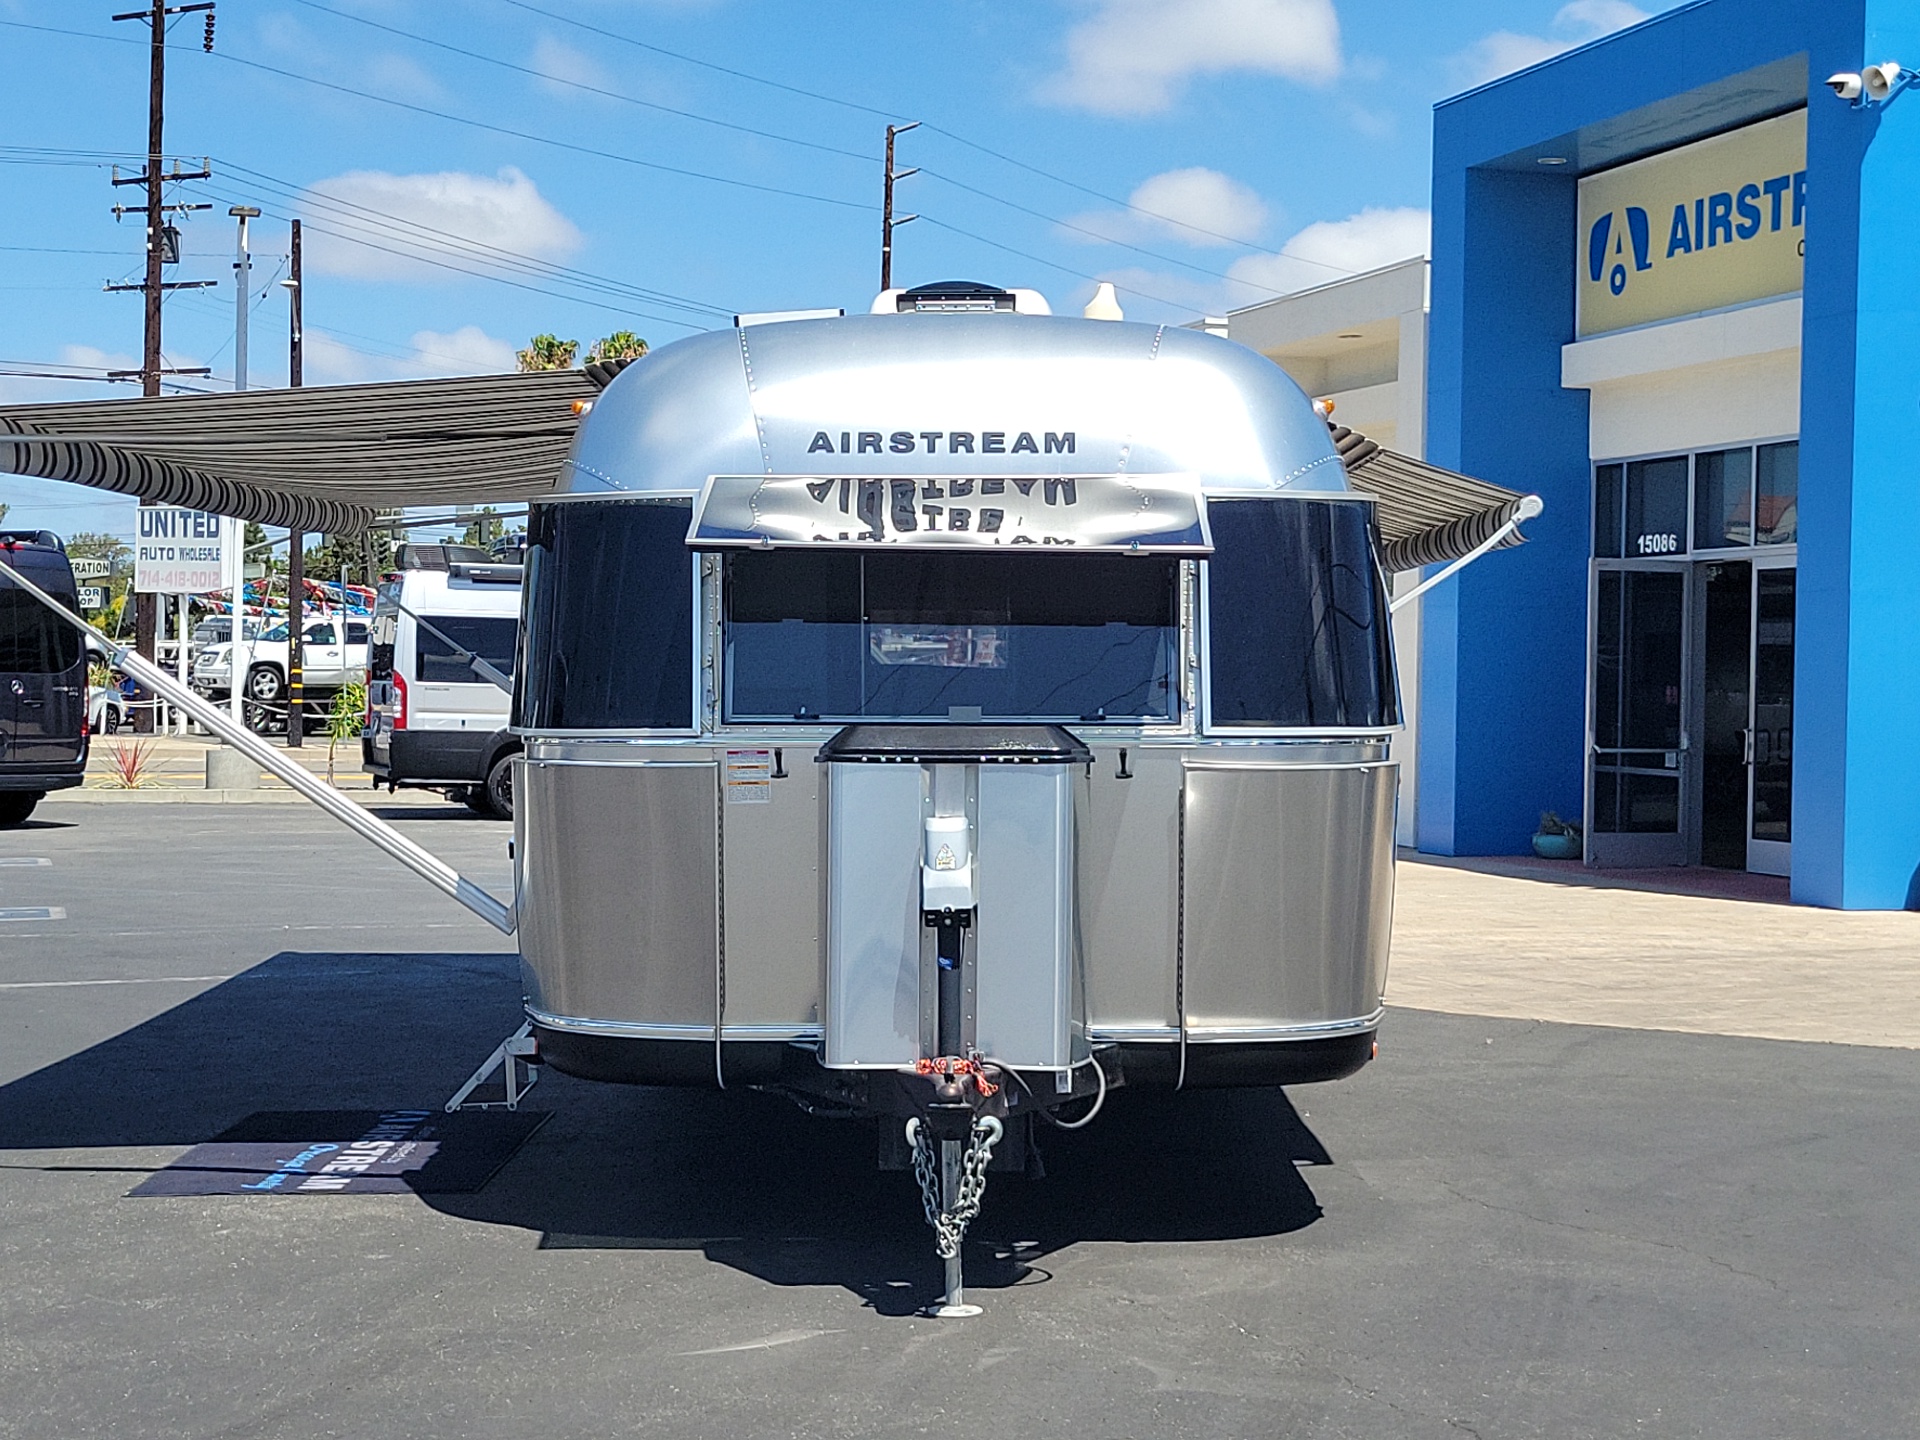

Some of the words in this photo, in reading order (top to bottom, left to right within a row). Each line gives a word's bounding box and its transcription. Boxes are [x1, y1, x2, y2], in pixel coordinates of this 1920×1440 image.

[807, 432, 1076, 454] AIRSTREAM
[140, 511, 220, 538] UNITED
[140, 547, 175, 561] AUTO
[179, 547, 220, 561] WHOLESALE
[1637, 533, 1677, 554] 15086
[139, 570, 220, 588] 714-418-0012
